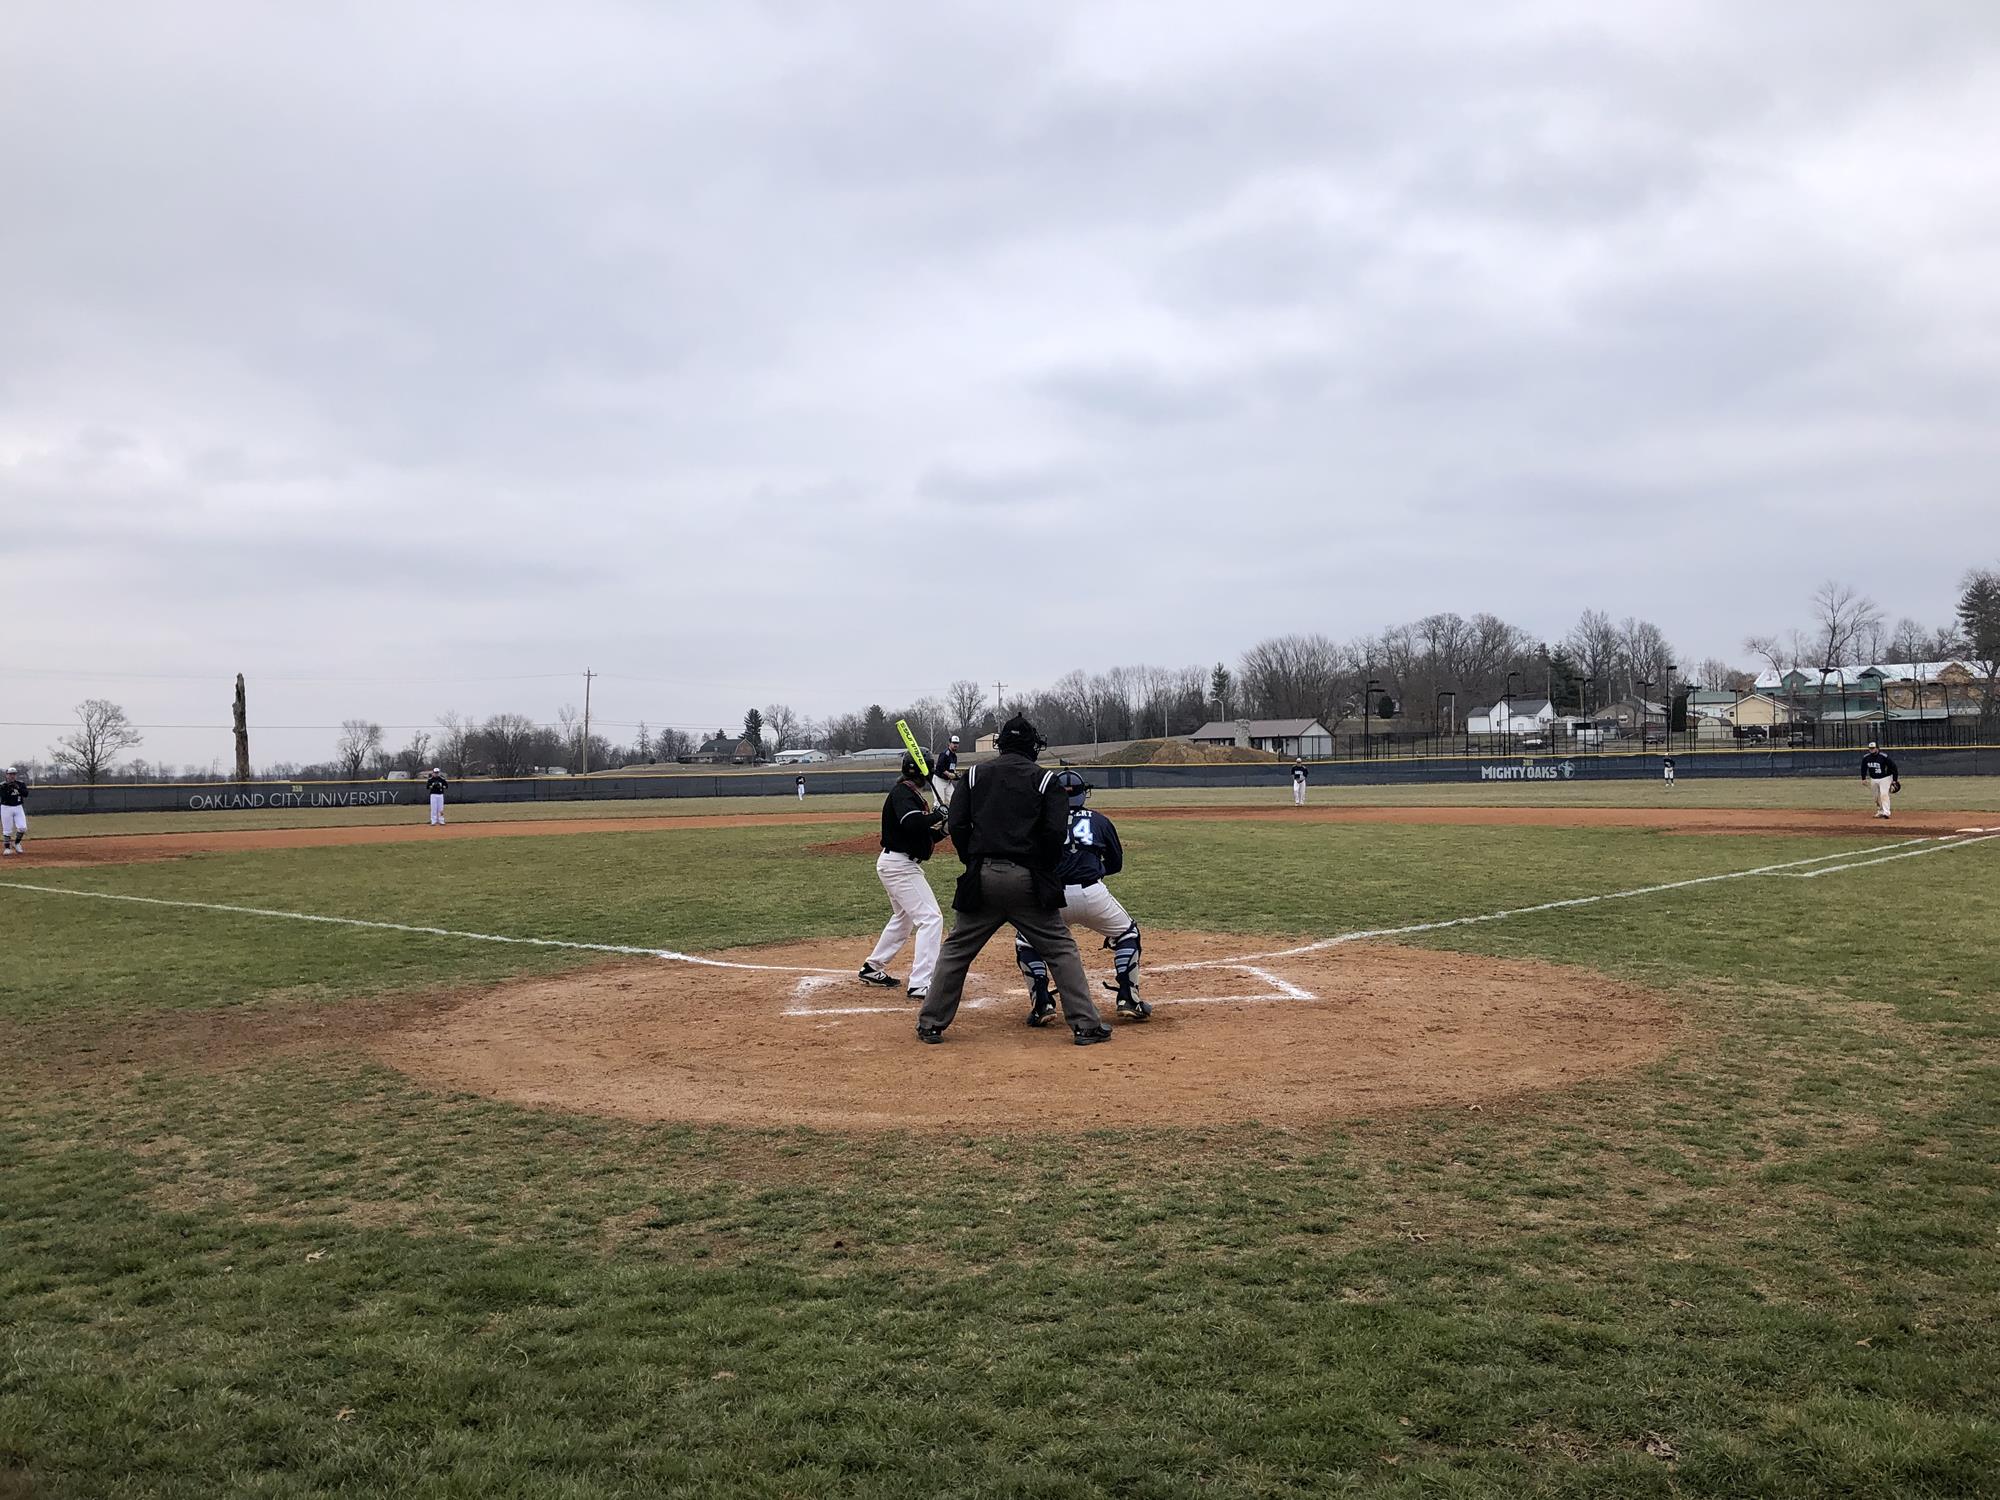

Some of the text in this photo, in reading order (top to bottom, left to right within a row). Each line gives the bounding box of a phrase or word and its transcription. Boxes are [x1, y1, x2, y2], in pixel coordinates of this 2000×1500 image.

[1481, 766, 1558, 779] MIGHTY OAKS
[189, 790, 399, 809] OAKLAND CITY UNIVERSITY
